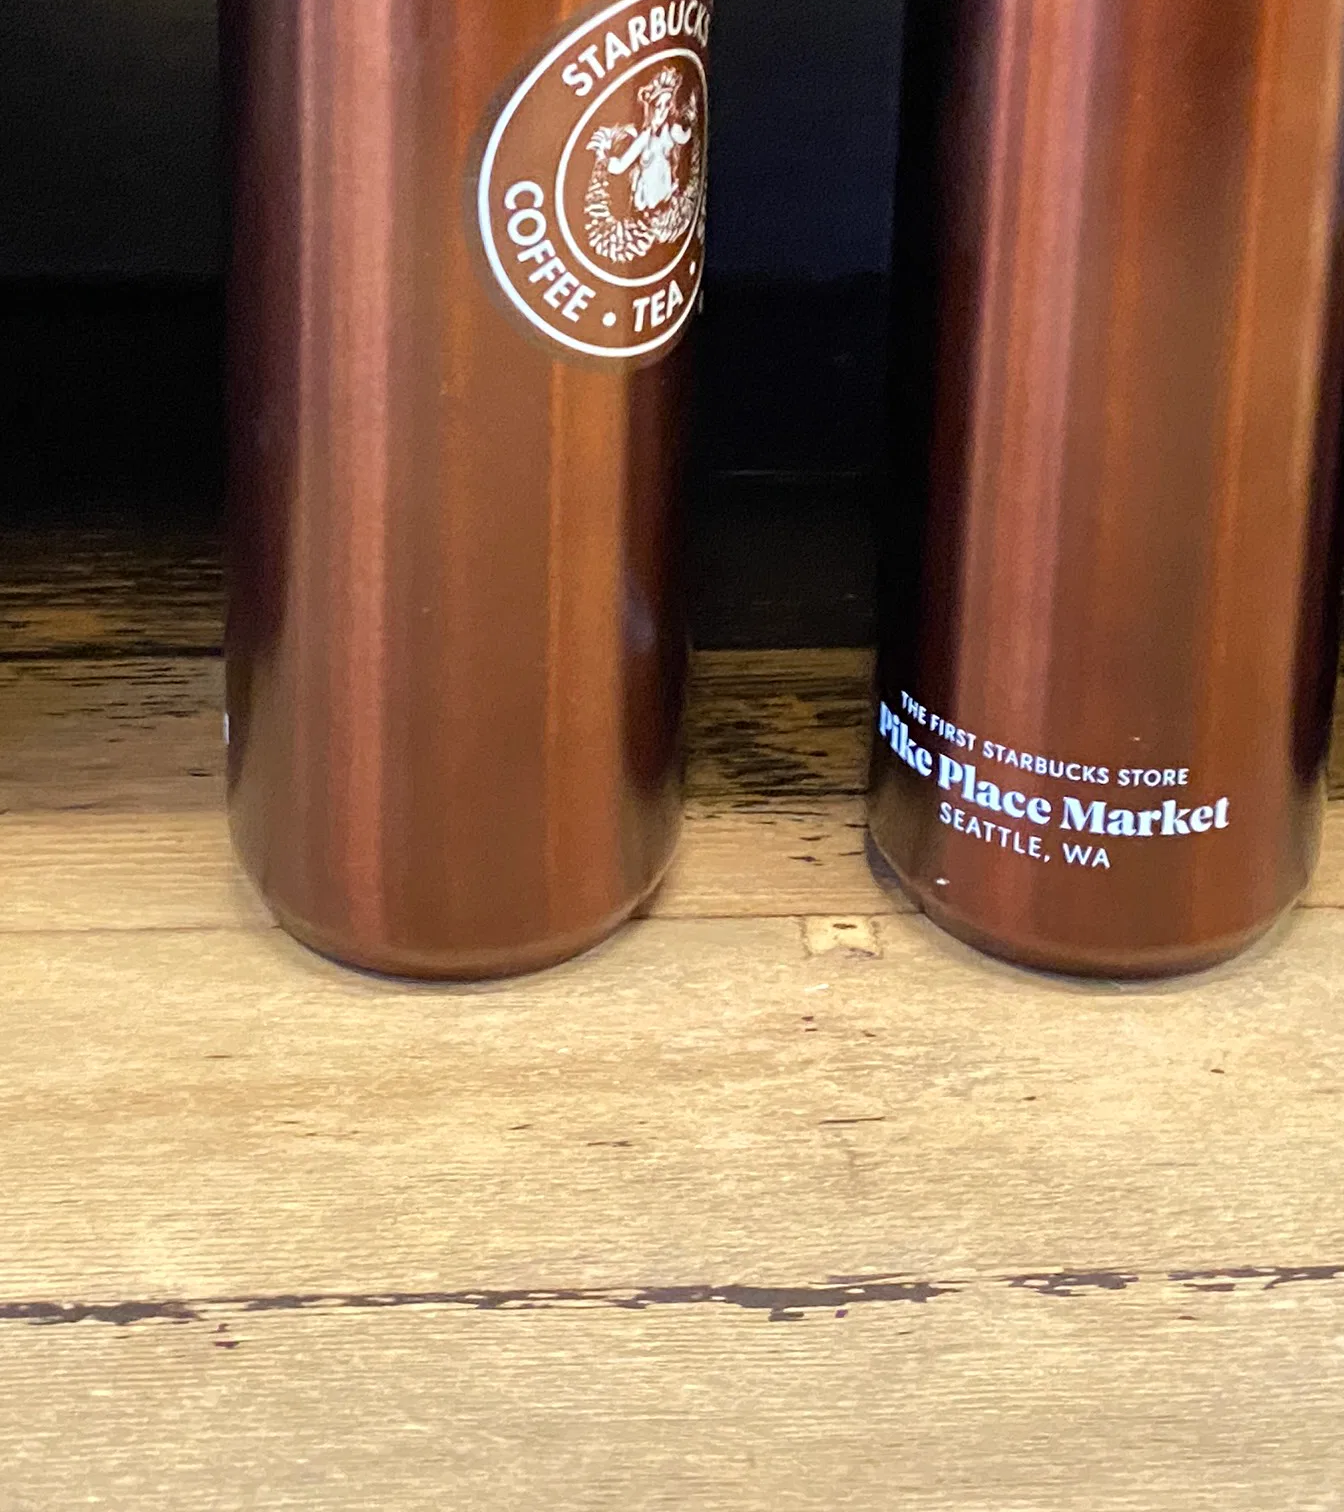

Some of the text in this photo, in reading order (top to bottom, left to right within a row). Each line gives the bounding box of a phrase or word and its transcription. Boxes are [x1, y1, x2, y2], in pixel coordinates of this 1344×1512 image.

[504, 180, 685, 333] COFFEE TEA
[879, 700, 1231, 837] Pike Place Market
[900, 689, 1190, 788] THE FIRST STARBUCKS STORE
[940, 801, 1112, 870] SEATTLE, WA
